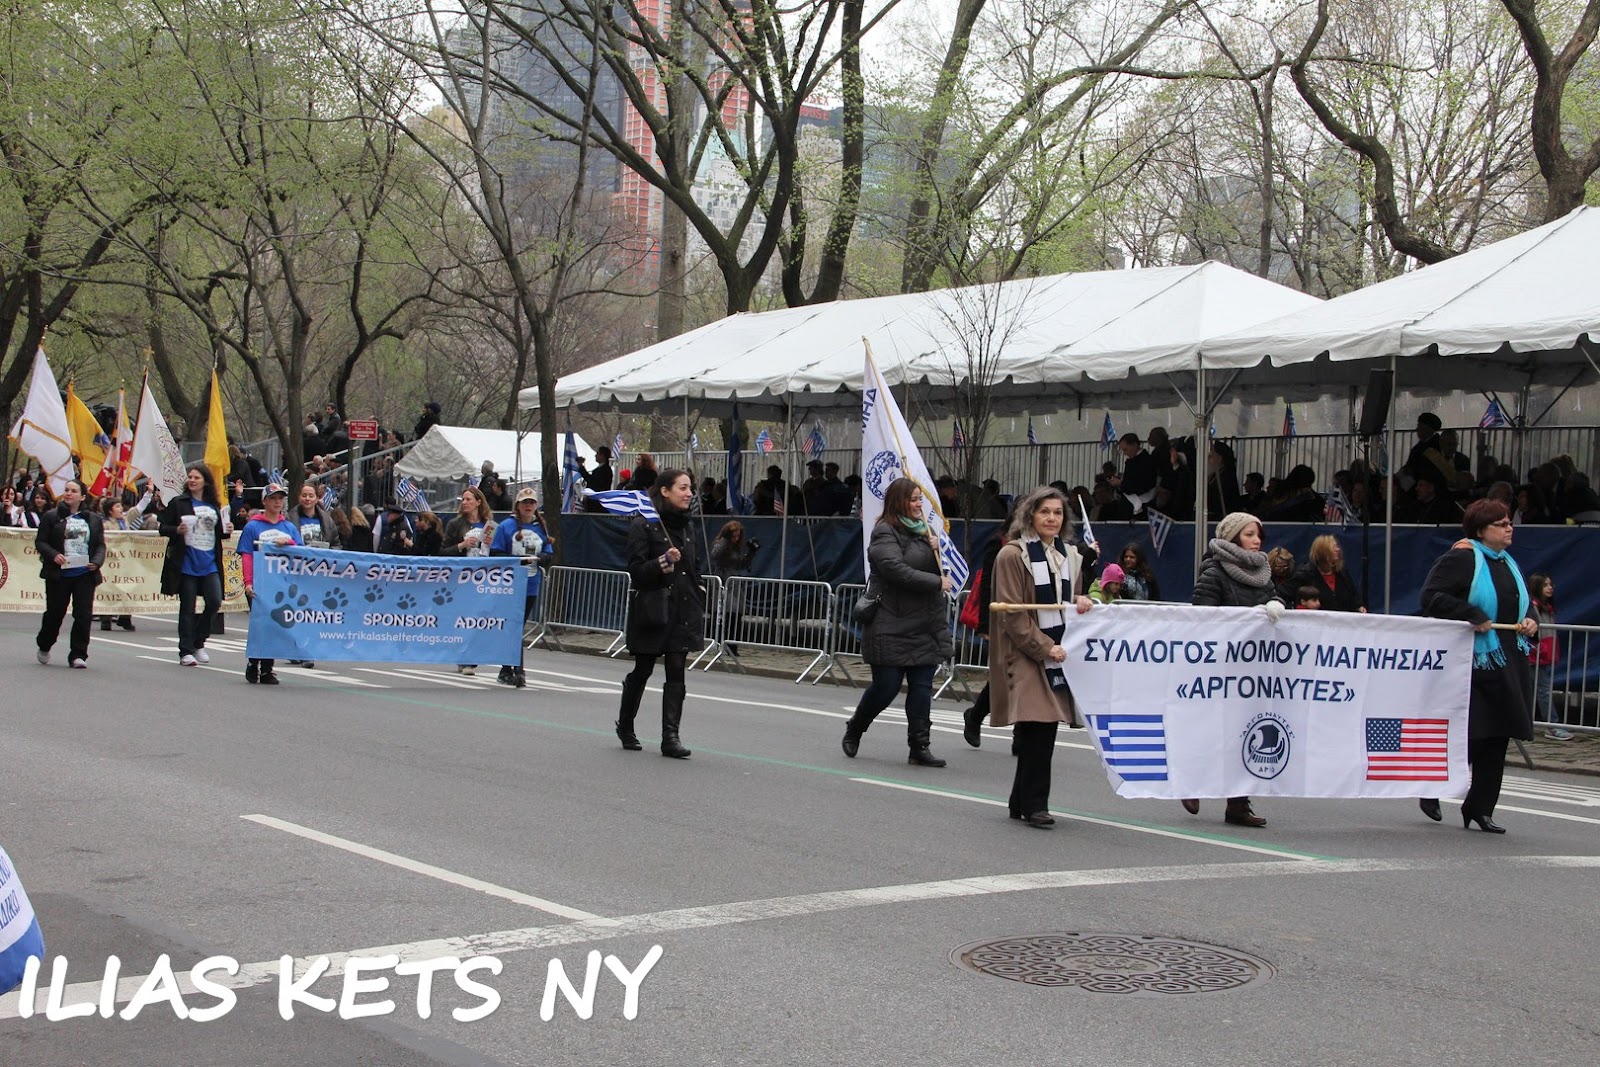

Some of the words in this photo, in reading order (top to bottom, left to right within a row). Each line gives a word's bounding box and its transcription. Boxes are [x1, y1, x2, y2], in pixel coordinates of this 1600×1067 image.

[264, 553, 358, 580] TRIKALA
[364, 563, 453, 585] SHELTER
[457, 566, 515, 587] DOGS
[476, 584, 514, 595] Greece
[283, 608, 345, 625] DONATE
[362, 612, 438, 629] SPONSOR
[454, 616, 506, 631] ADOPT
[319, 630, 464, 645] www.trikalashelterdogs.com
[1083, 638, 1218, 664] ΣΥΛΛΟΓΟΣ
[1225, 639, 1311, 667] ΝΟΜΟΥ
[1315, 644, 1448, 672] ΜΑΓΝΗΣΙΑΣ
